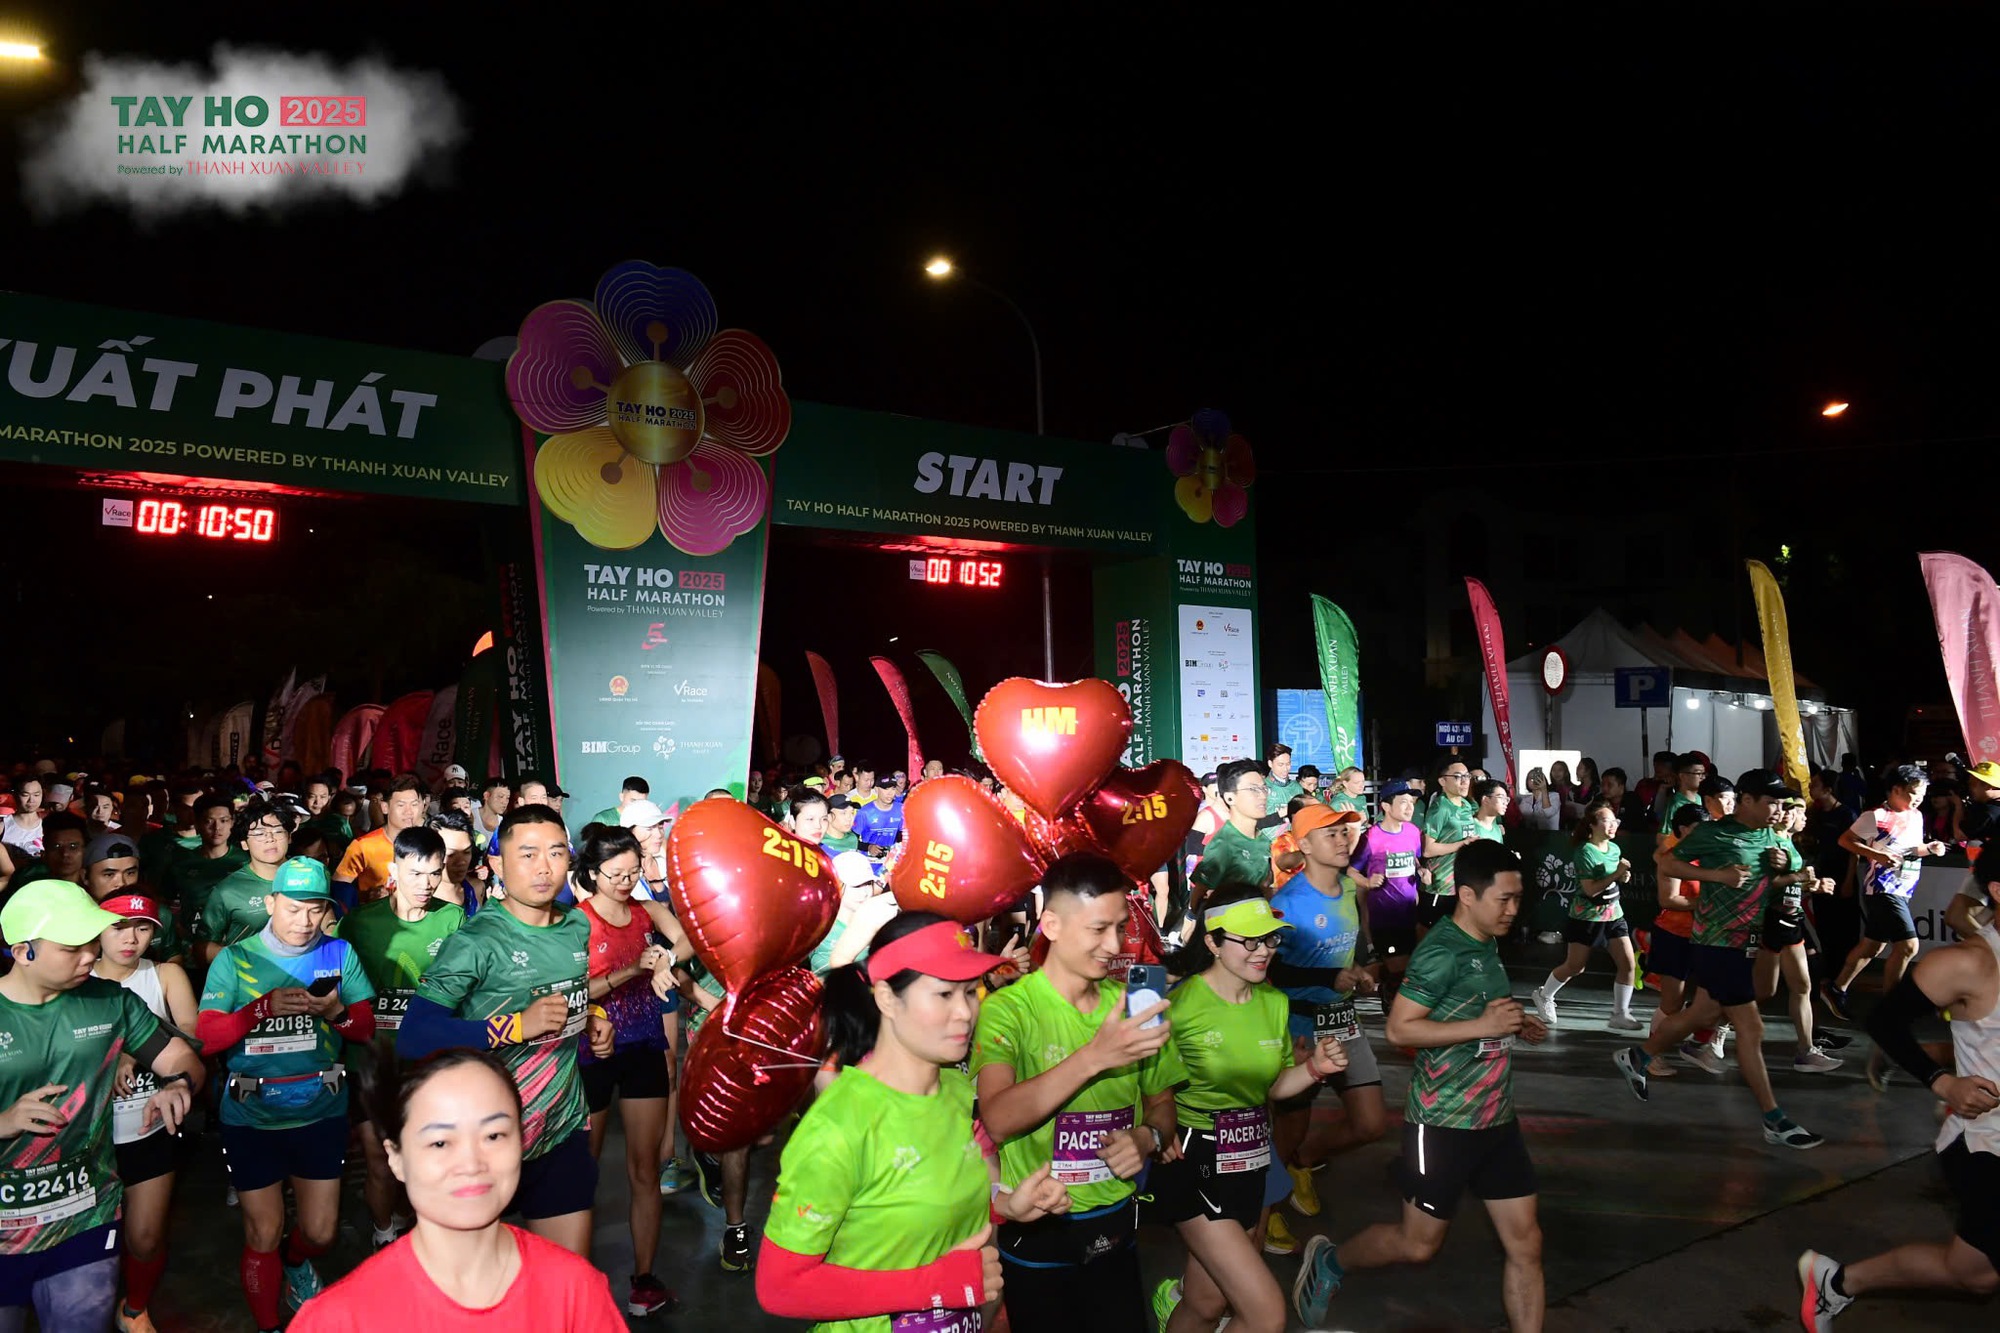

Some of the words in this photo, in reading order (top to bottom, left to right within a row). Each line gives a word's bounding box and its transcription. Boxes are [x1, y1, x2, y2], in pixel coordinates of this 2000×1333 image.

[214, 368, 438, 439] PHÁT
[617, 402, 642, 413] TAY
[646, 405, 666, 417] HO
[671, 409, 695, 420] 2025
[128, 437, 178, 455] 2025
[182, 442, 287, 466] POWERED
[292, 454, 318, 468] BY
[322, 457, 387, 477] THANH
[392, 465, 441, 481] XUAN
[446, 469, 510, 488] VALLEY
[913, 451, 1064, 506] START
[786, 499, 811, 512] TAY
[814, 501, 834, 514] HO
[837, 504, 870, 518] HALF
[872, 508, 942, 526] MARATHON
[944, 515, 970, 529] 2025
[973, 518, 1030, 534] POWERED
[1032, 523, 1046, 535] BY
[1048, 525, 1085, 538] THANH
[1086, 528, 1115, 540] XUAN
[1116, 531, 1153, 542] VALLEY
[584, 564, 631, 585] TAY
[637, 568, 673, 588] HO
[683, 573, 722, 588] 2025
[1177, 559, 1201, 573] TAY
[1204, 562, 1224, 576] HO
[1179, 574, 1200, 584] HALF
[1204, 577, 1251, 588] MARATHON
[587, 588, 628, 601] HALF
[635, 591, 725, 607] MARATHON
[587, 605, 616, 613] Powered
[616, 606, 625, 614] by
[626, 605, 659, 614] THANH
[662, 608, 687, 617] XUAN
[688, 609, 724, 617] VALLEY
[1117, 625, 1129, 672] 2025
[507, 646, 519, 700] HO
[1132, 618, 1144, 725] MARATHON
[1629, 675, 1655, 700] P
[1144, 698, 1152, 734] THANH
[512, 709, 527, 777] TAY
[522, 713, 534, 771] HALF
[582, 741, 640, 753] BIMGroup
[1134, 733, 1145, 766] ALF
[1121, 795, 1168, 825] 2:15
[763, 827, 819, 878] 2:15
[919, 840, 954, 899] 2:15
[314, 970, 333, 978] BIDV
[378, 998, 389, 1010] B
[265, 1015, 313, 1032] 20185
[1317, 1015, 1326, 1026] D
[1220, 1125, 1255, 1145] PACER
[0, 1184, 16, 1203] C
[22, 1166, 89, 1202] 22416
